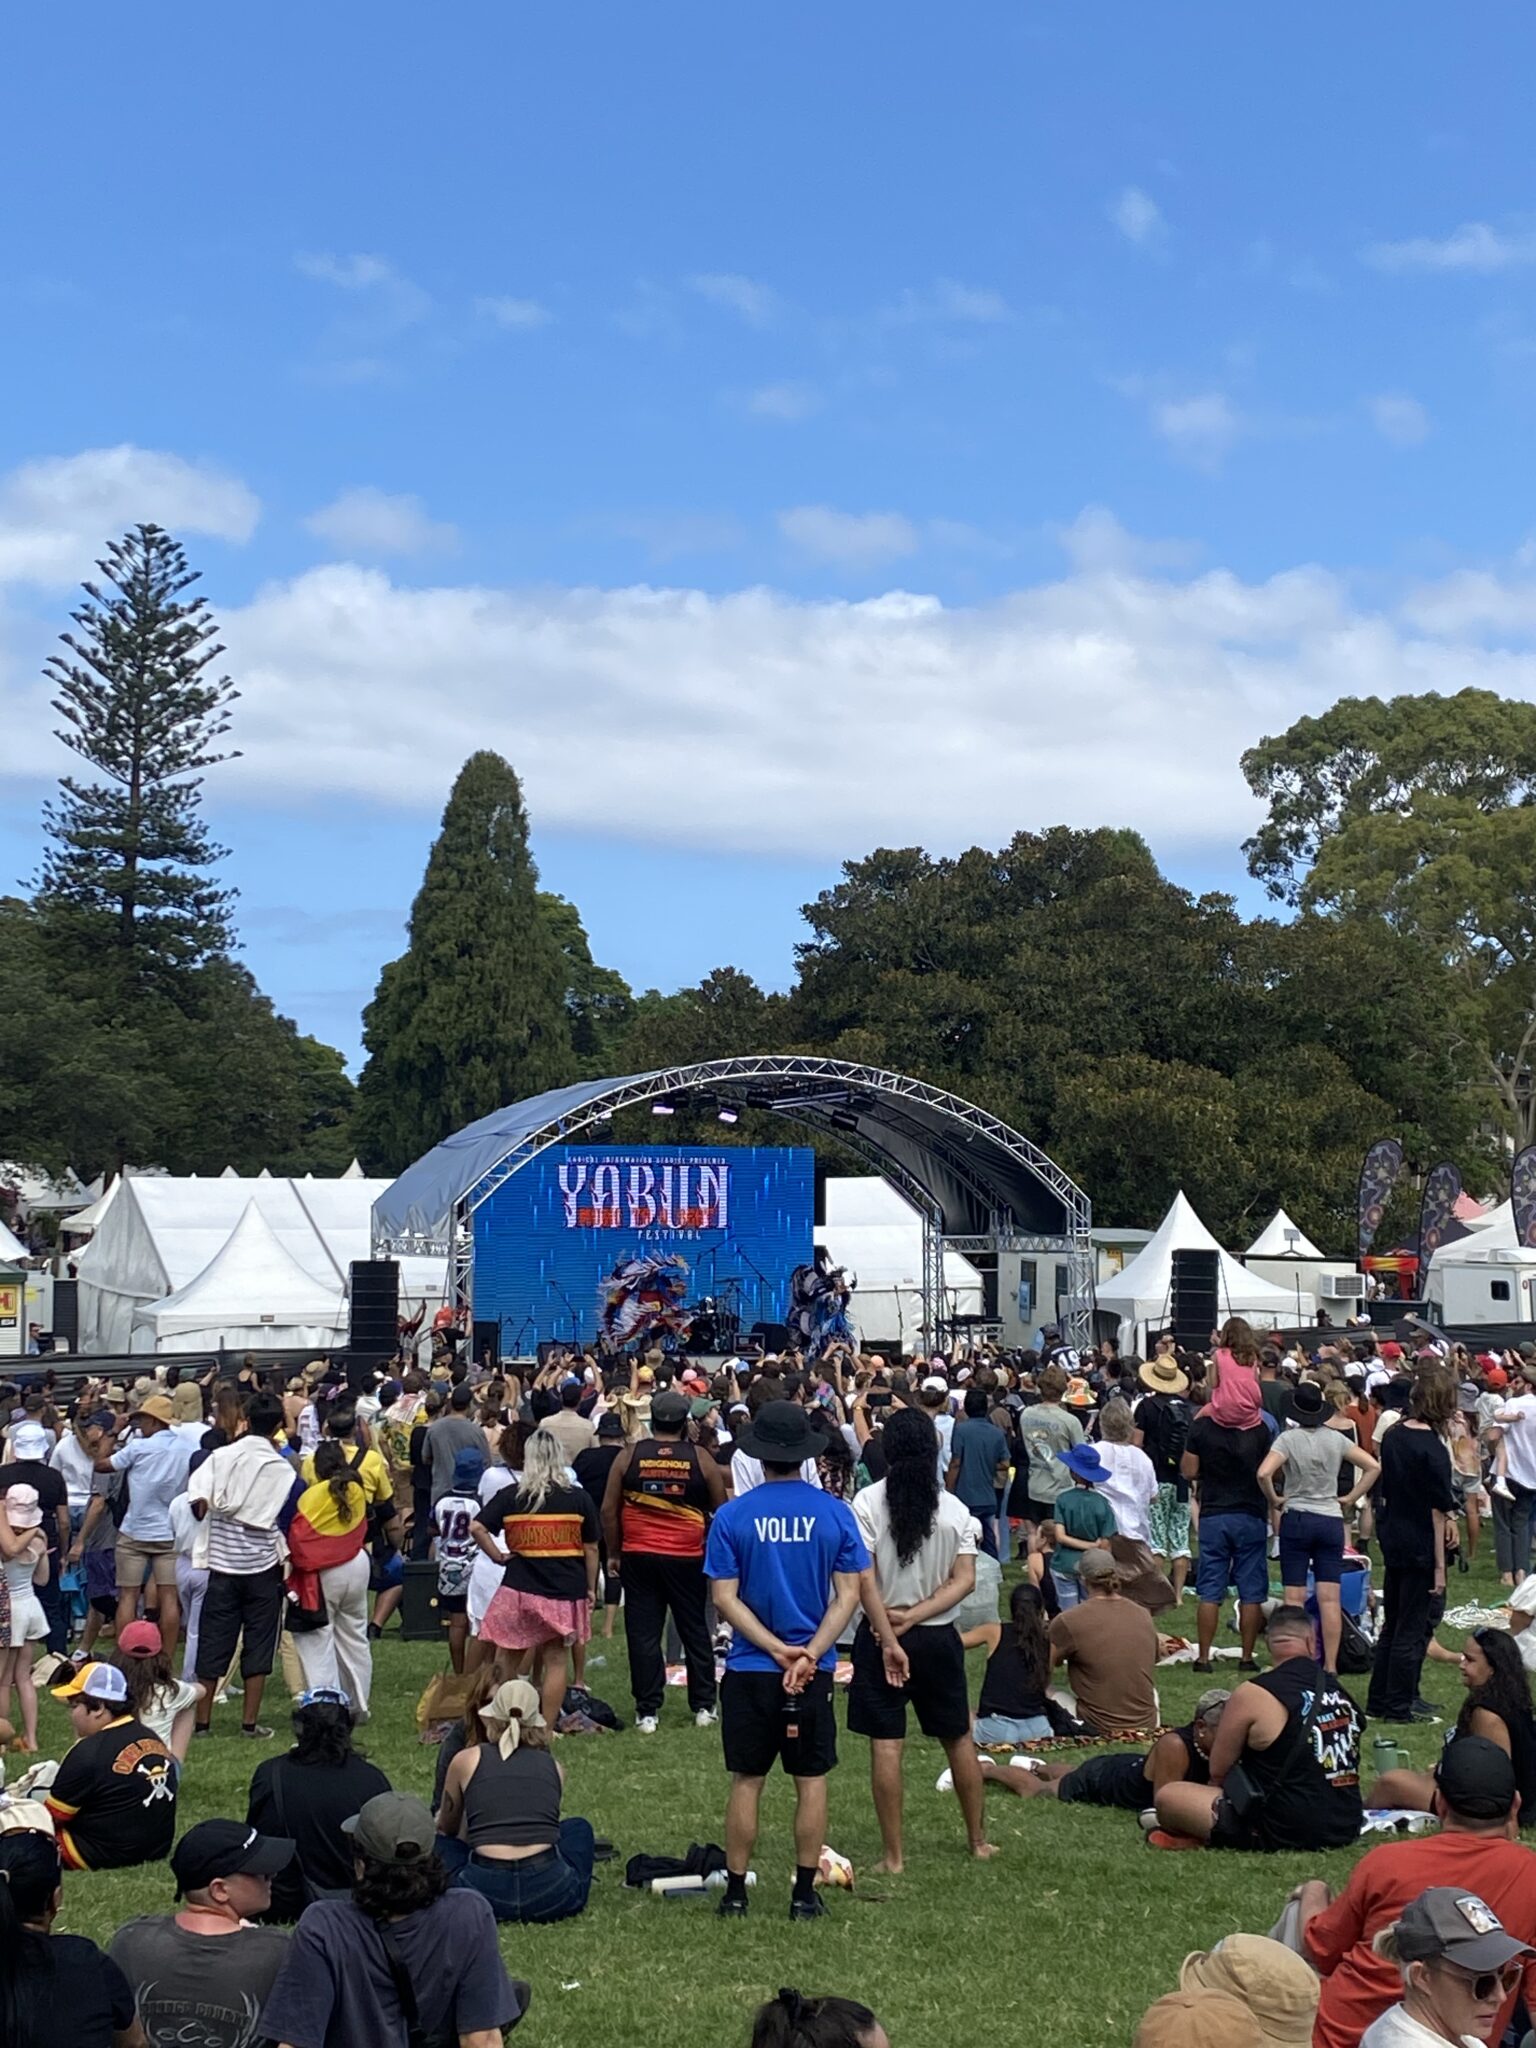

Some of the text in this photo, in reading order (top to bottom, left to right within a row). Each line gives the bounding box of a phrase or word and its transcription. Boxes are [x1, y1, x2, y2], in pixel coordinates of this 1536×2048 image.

[558, 1165, 728, 1228] YABUN
[638, 1230, 701, 1241] FESTIVAL
[639, 1459, 691, 1470] INDIGENOUS
[753, 1516, 817, 1543] VOLLY
